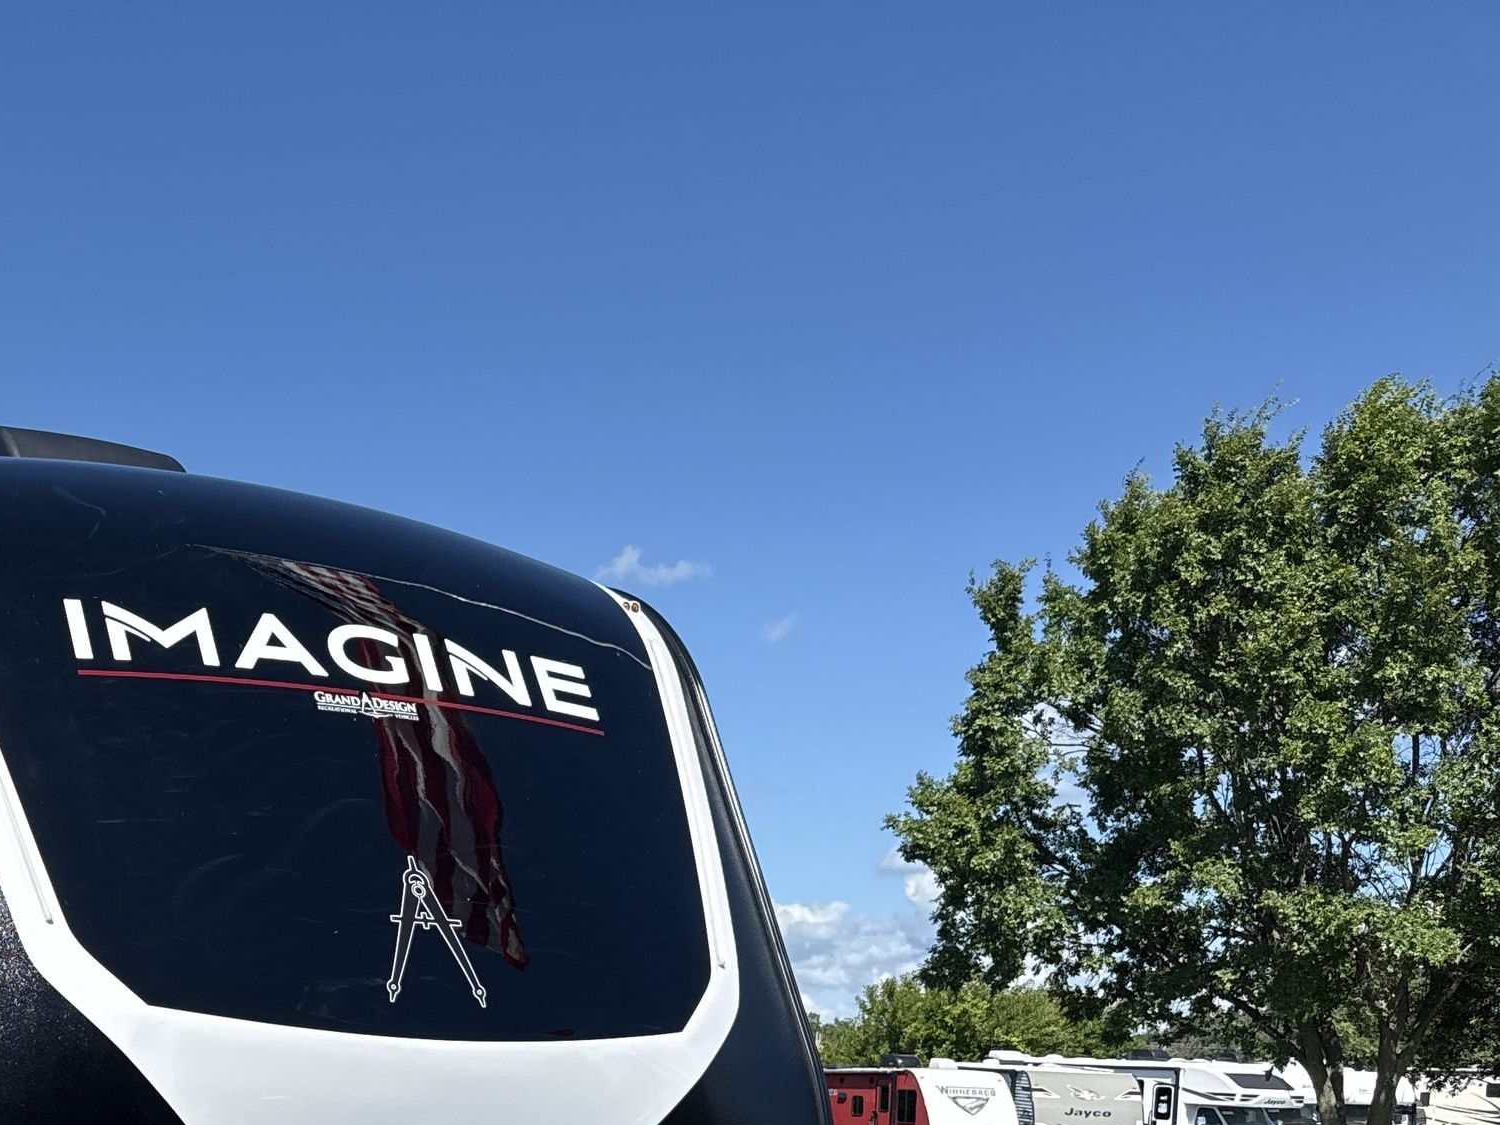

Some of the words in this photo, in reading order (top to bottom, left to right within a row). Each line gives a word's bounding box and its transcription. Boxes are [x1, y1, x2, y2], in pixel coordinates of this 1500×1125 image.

[63, 597, 600, 722] IMAGINE
[313, 690, 361, 706] GRAND
[370, 696, 417, 713] DESIGN
[935, 1085, 996, 1097] WINNEBAGO
[1064, 1107, 1112, 1119] Jayco
